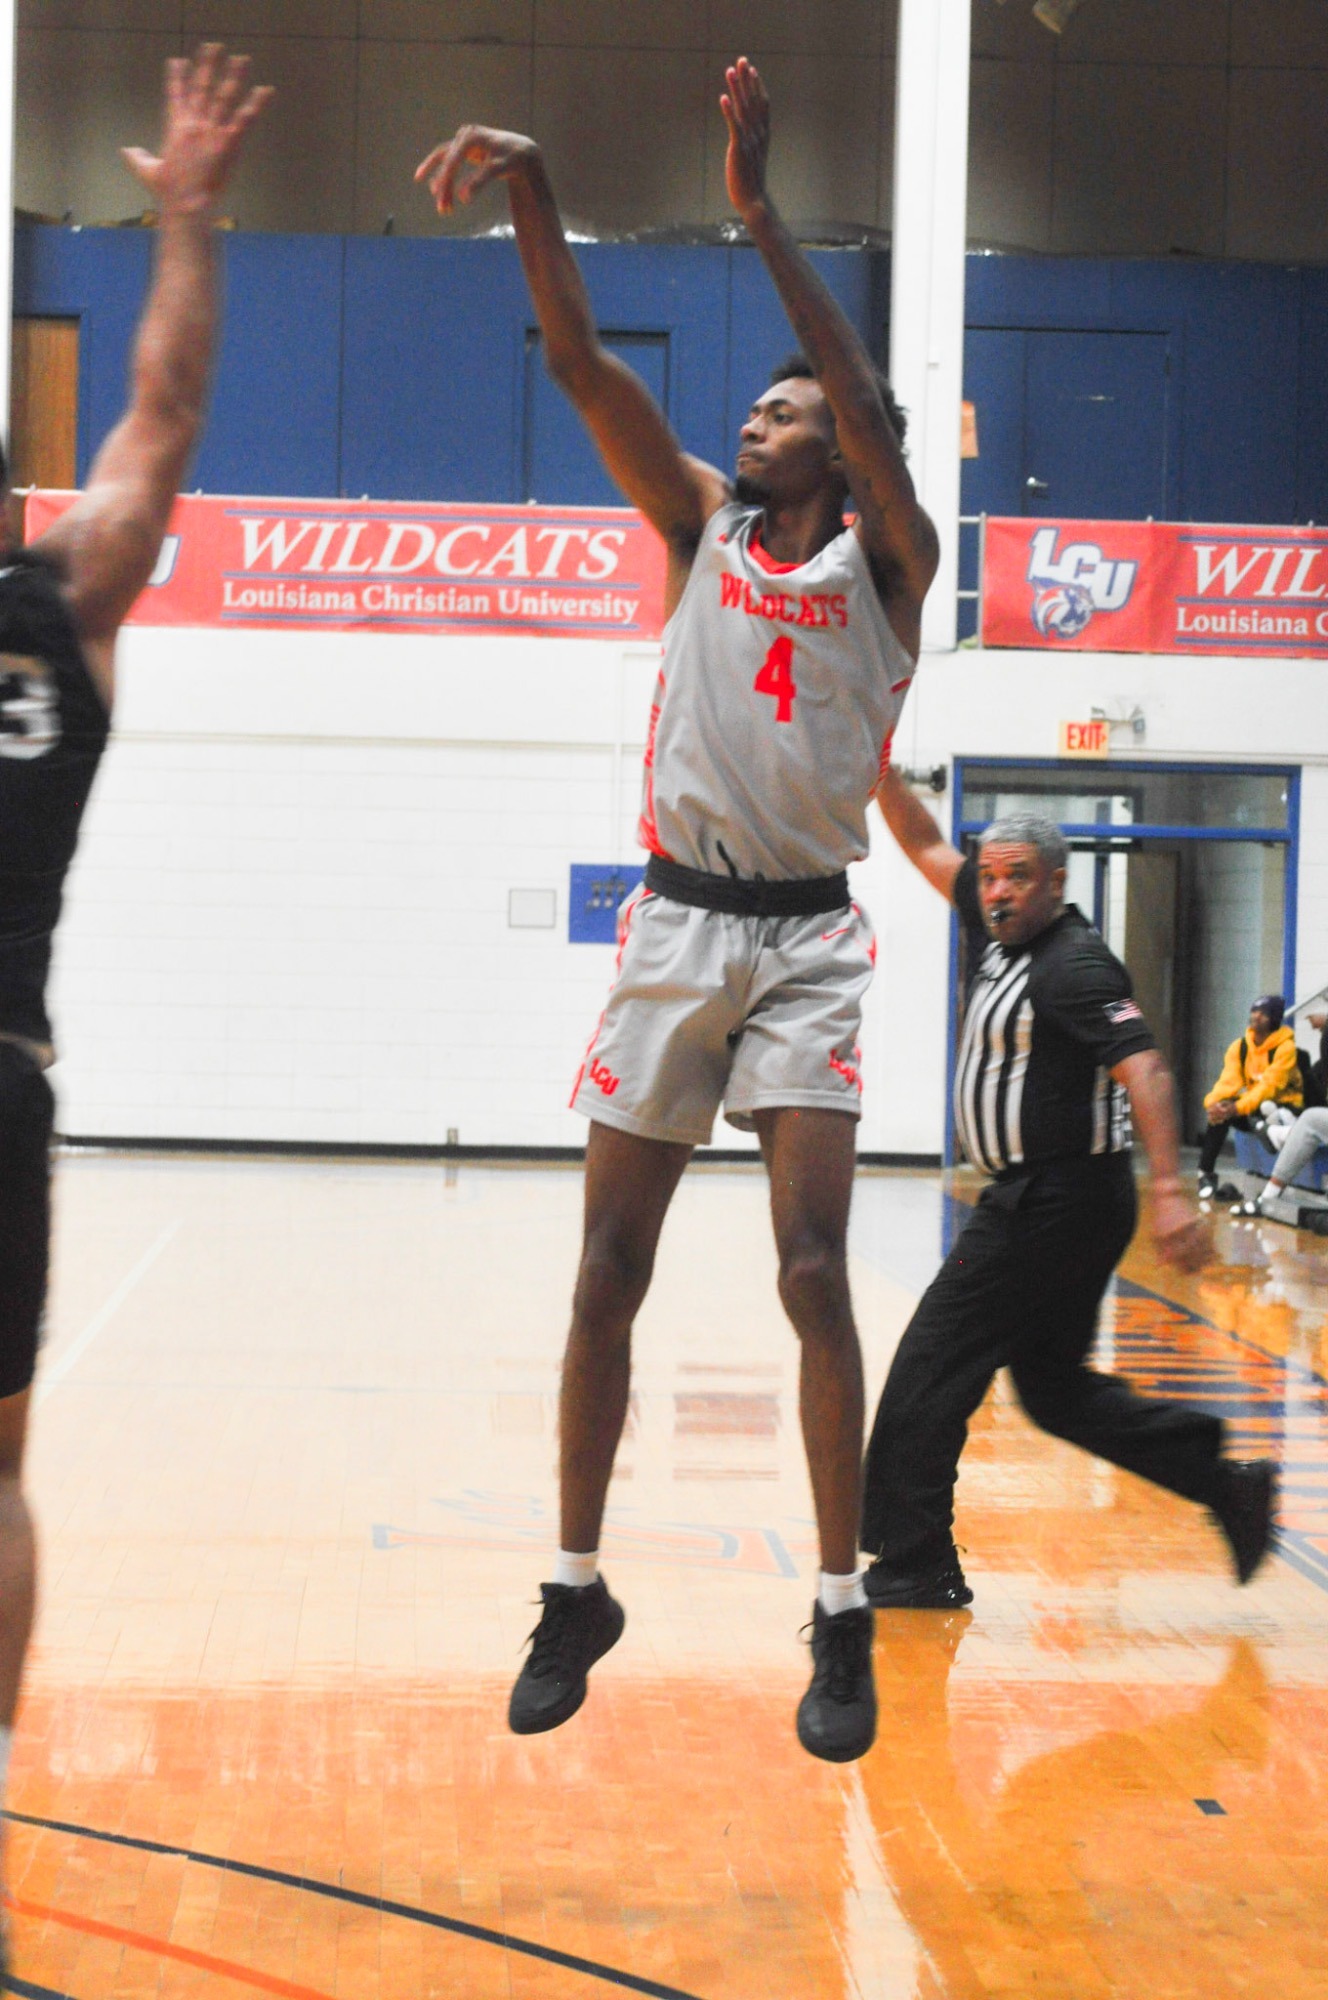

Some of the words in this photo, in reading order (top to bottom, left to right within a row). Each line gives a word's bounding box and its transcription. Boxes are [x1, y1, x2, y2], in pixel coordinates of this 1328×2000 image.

[240, 518, 627, 580] WILDCATS
[1028, 527, 1138, 613] LCU
[1193, 544, 1328, 598] WIL
[222, 581, 357, 611] Louisiana
[361, 585, 491, 614] Christian
[498, 589, 639, 624] University
[1175, 607, 1309, 636] Louisiana
[753, 635, 797, 724] 4
[1066, 723, 1102, 750] EXIT
[589, 1057, 621, 1096] LCU
